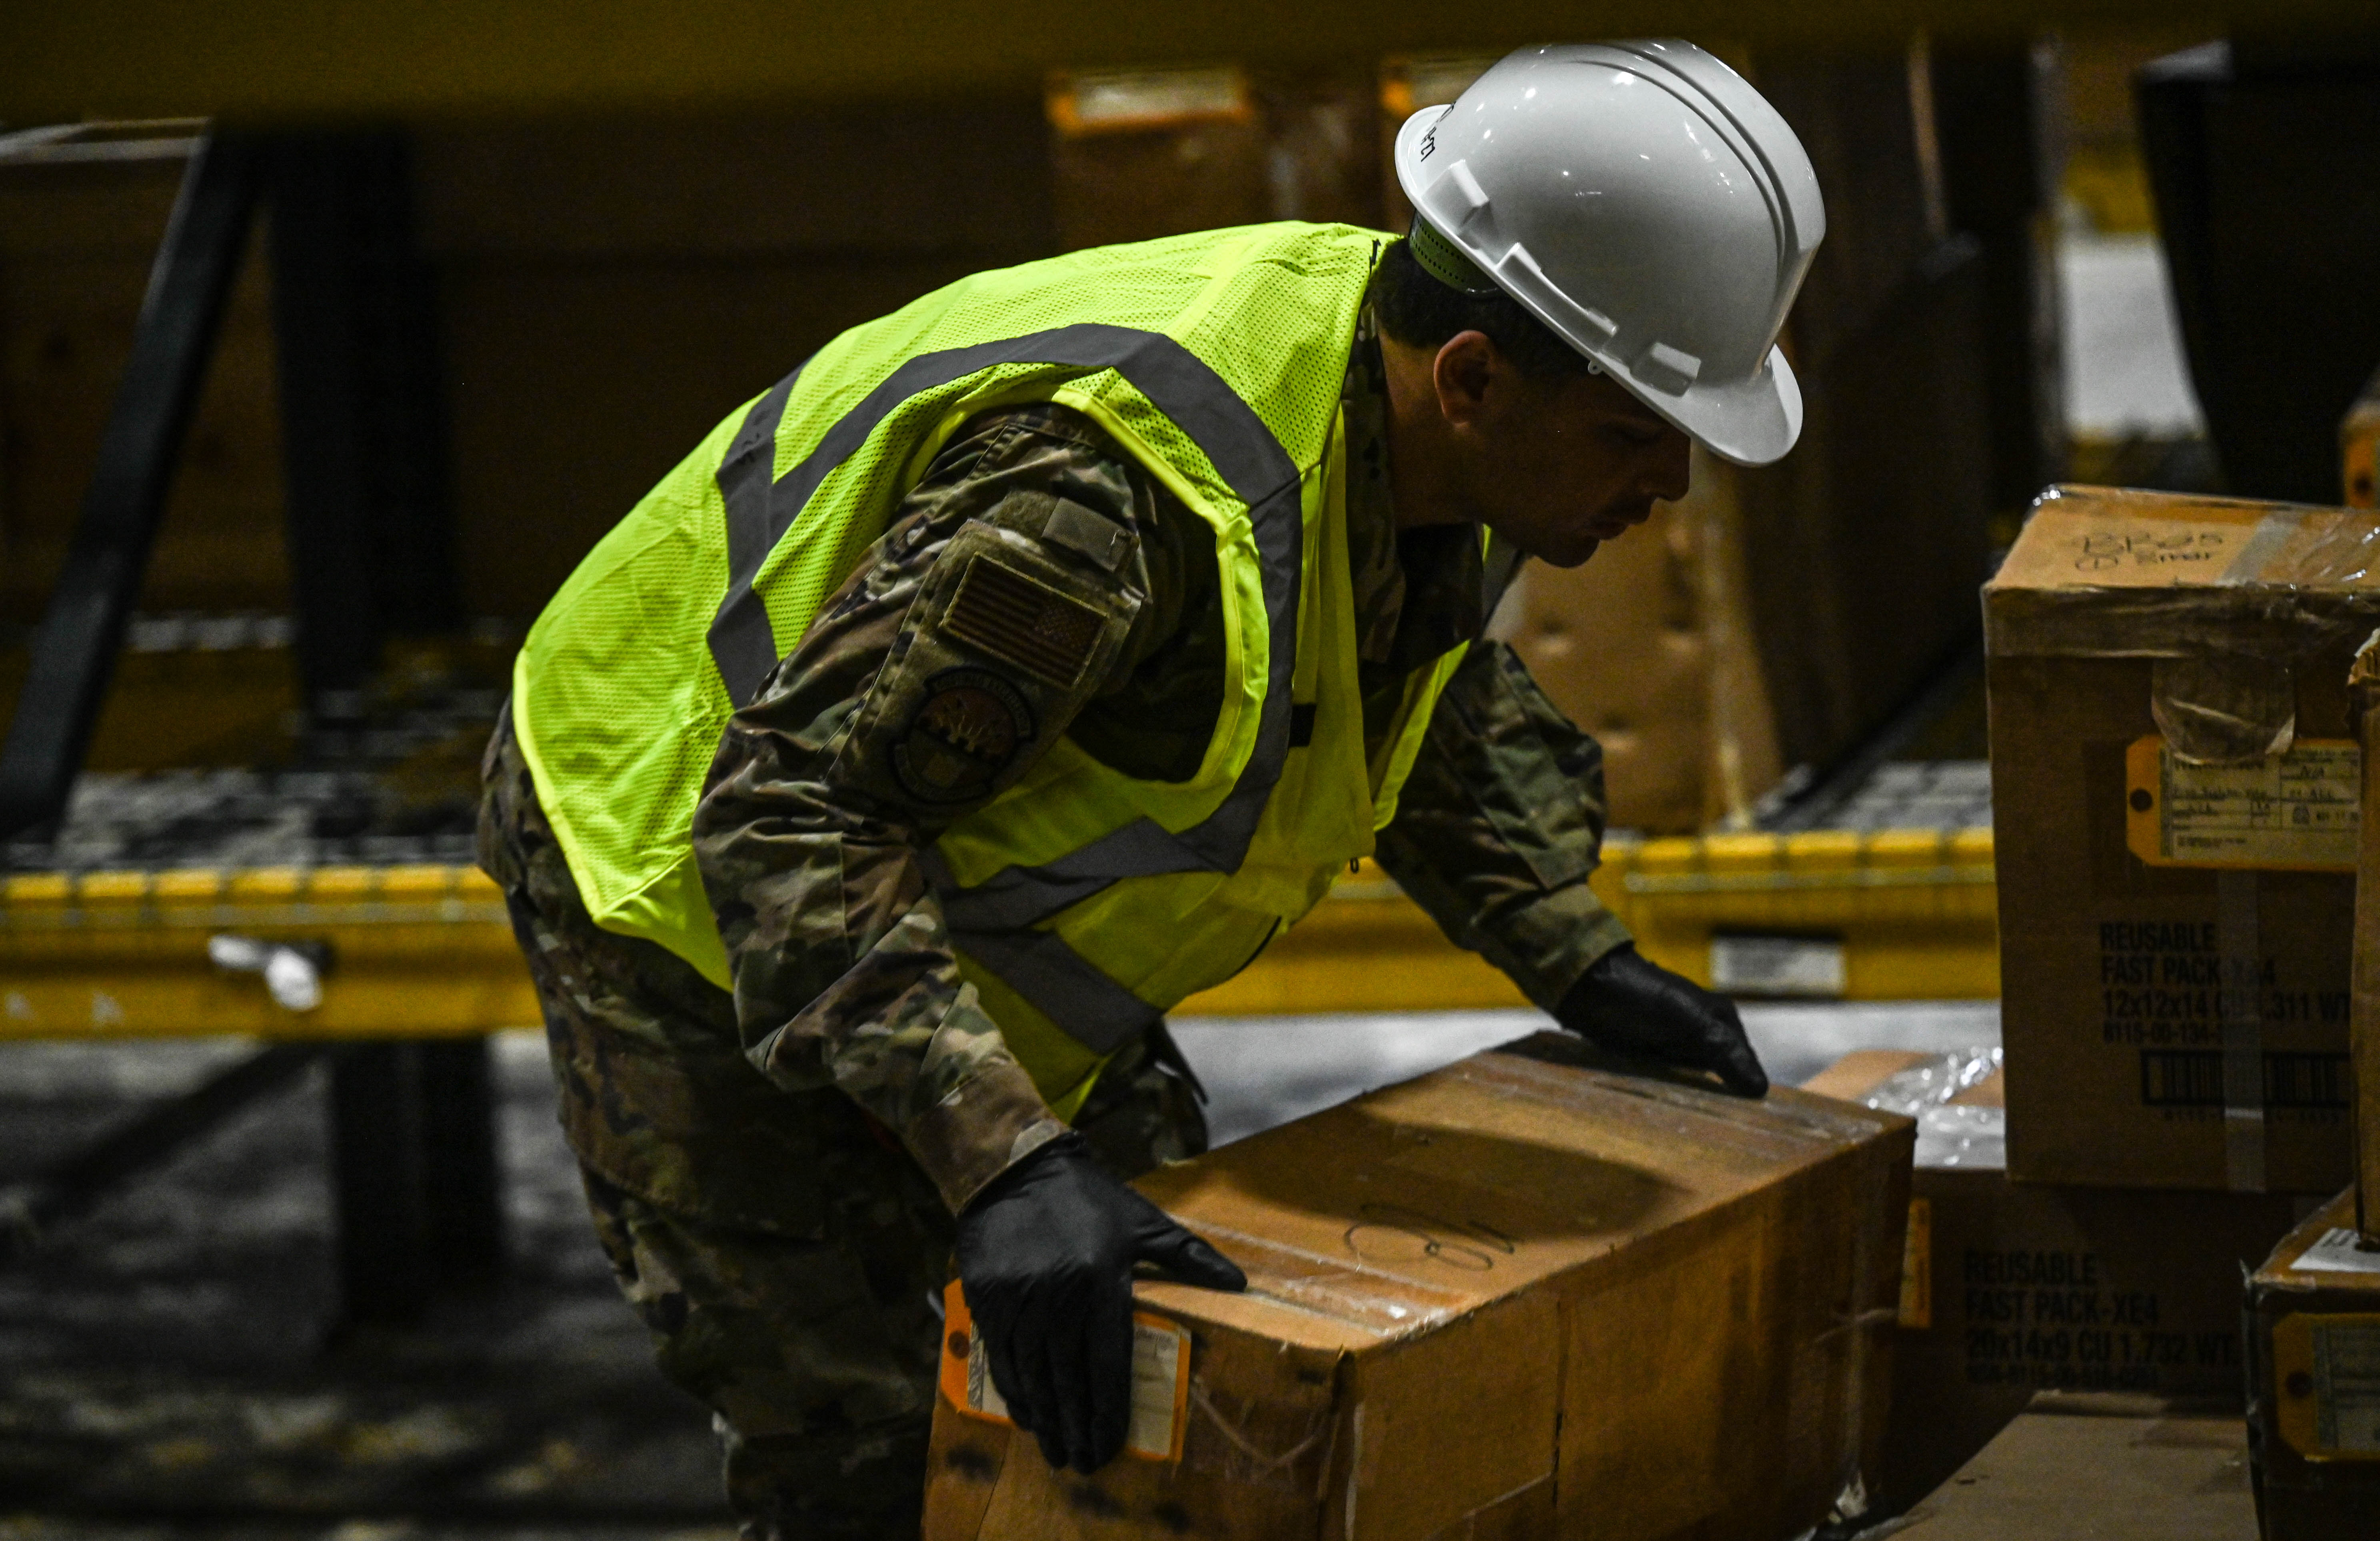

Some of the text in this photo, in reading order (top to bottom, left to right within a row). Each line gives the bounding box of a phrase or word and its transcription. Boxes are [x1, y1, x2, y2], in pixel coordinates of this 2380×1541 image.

[2100, 923, 2216, 951] REUSABLE
[2101, 957, 2155, 983] FAST
[2104, 989, 2208, 1018] 12x12x14
[1964, 1251, 2097, 1285] REUSABLE
[1965, 1290, 2027, 1321] FAST
[1966, 1328, 2070, 1361] 20x14x9
[2078, 1331, 2111, 1362] CU
